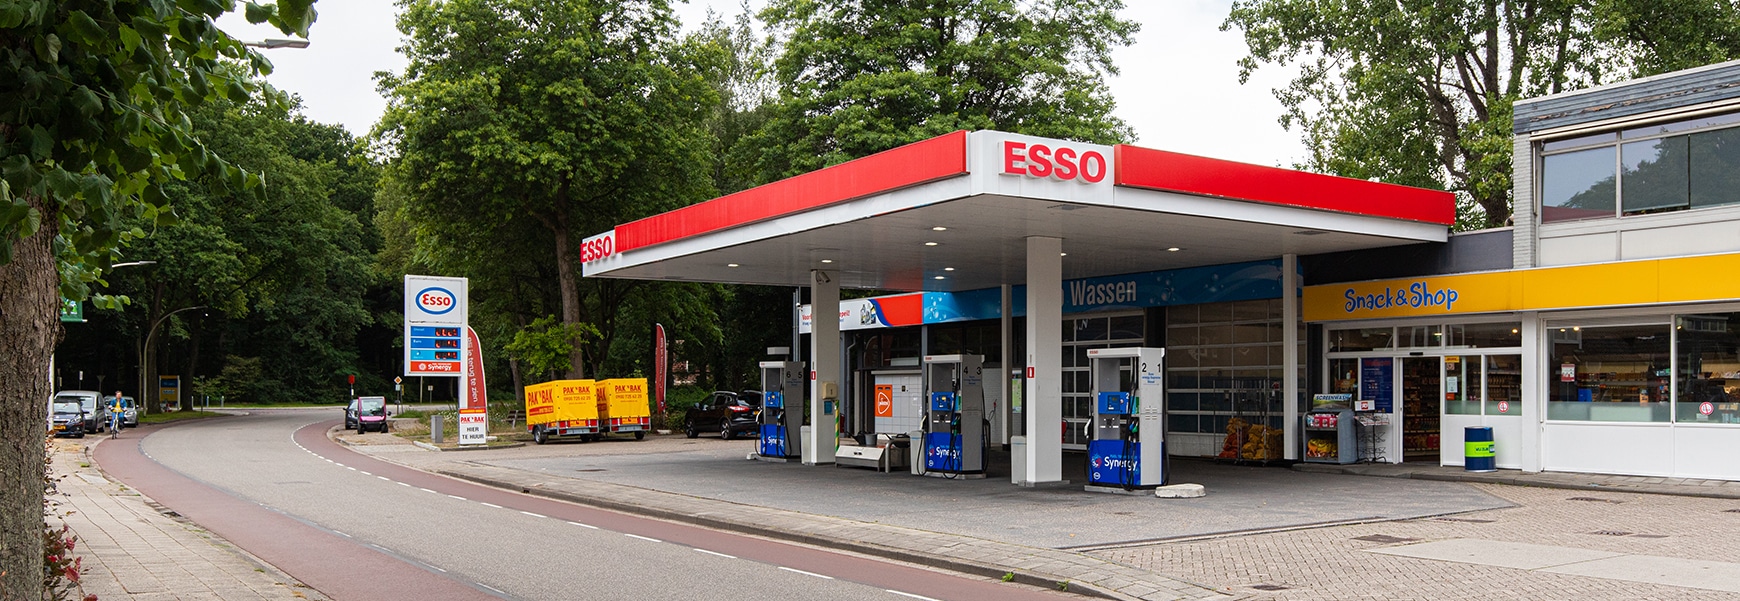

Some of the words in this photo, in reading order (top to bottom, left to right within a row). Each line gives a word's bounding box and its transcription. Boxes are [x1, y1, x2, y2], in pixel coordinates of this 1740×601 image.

[1004, 140, 1107, 183] ESSO
[580, 235, 612, 263] ESSO
[422, 293, 451, 306] Esso
[1070, 280, 1137, 306] Wassen
[1344, 288, 1393, 313] Snack
[1395, 289, 1408, 306] &
[1409, 281, 1459, 310] Shop
[963, 366, 968, 375] 4
[976, 367, 981, 375] 3
[1142, 363, 1146, 372] 2
[1157, 363, 1160, 372] 1
[470, 378, 476, 386] te
[528, 391, 538, 406] PAK
